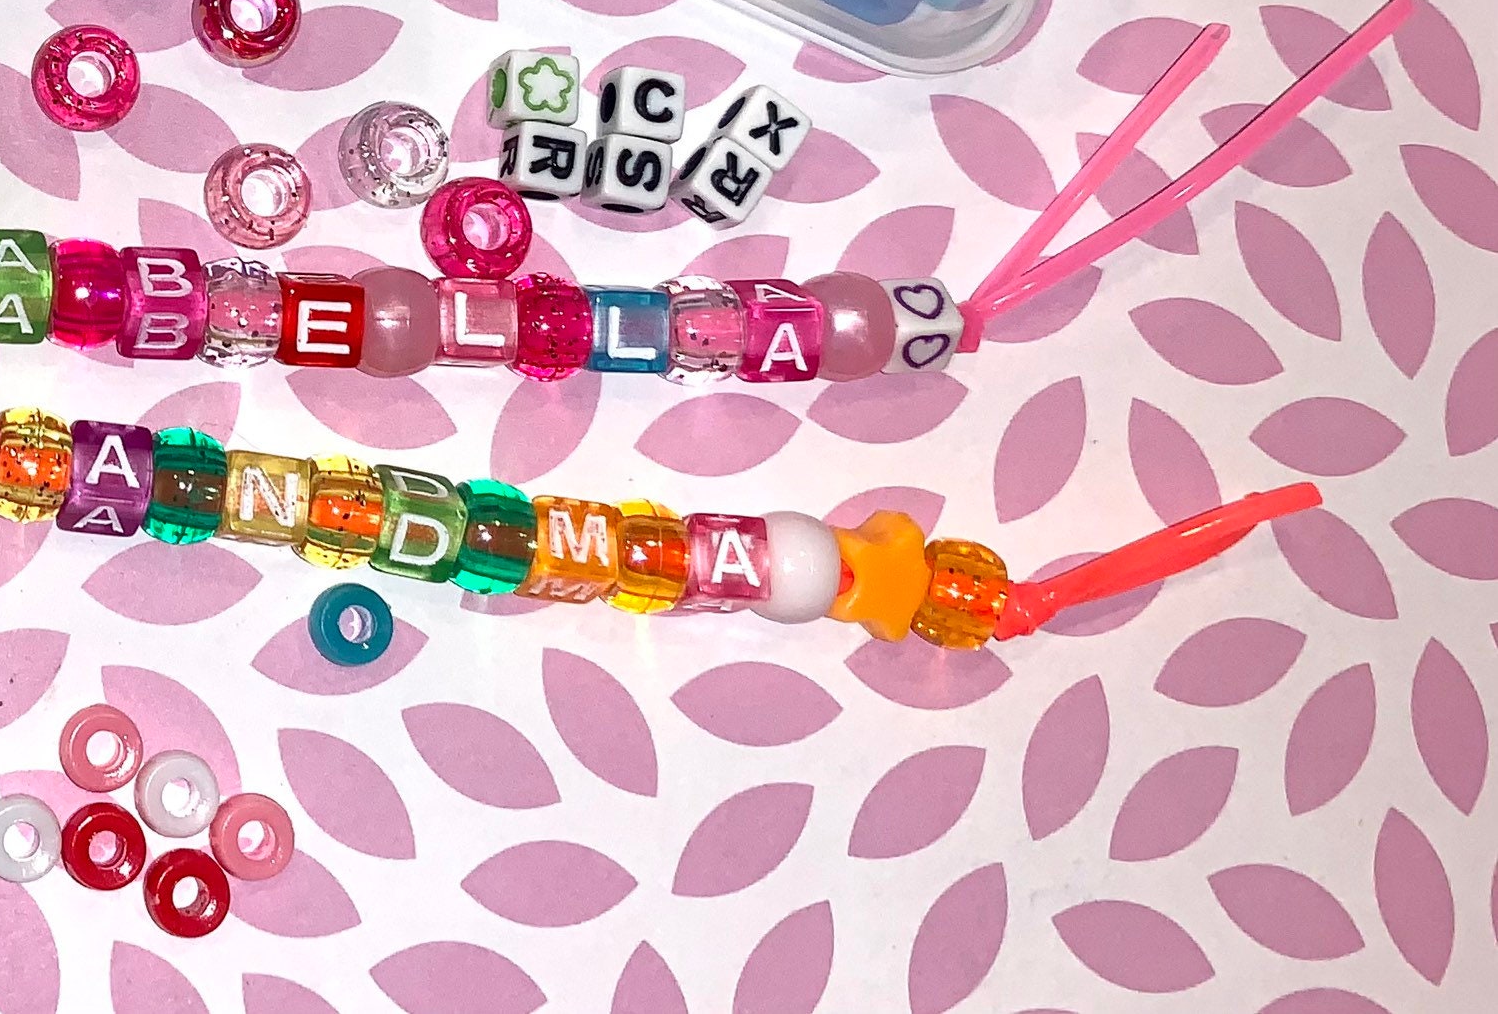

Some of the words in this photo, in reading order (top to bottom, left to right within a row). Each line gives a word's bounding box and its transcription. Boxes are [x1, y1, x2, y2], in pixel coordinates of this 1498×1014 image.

[633, 77, 677, 124] C
[748, 99, 800, 157] X
[528, 134, 577, 181] R
[615, 148, 663, 193] S
[709, 151, 761, 207] R
